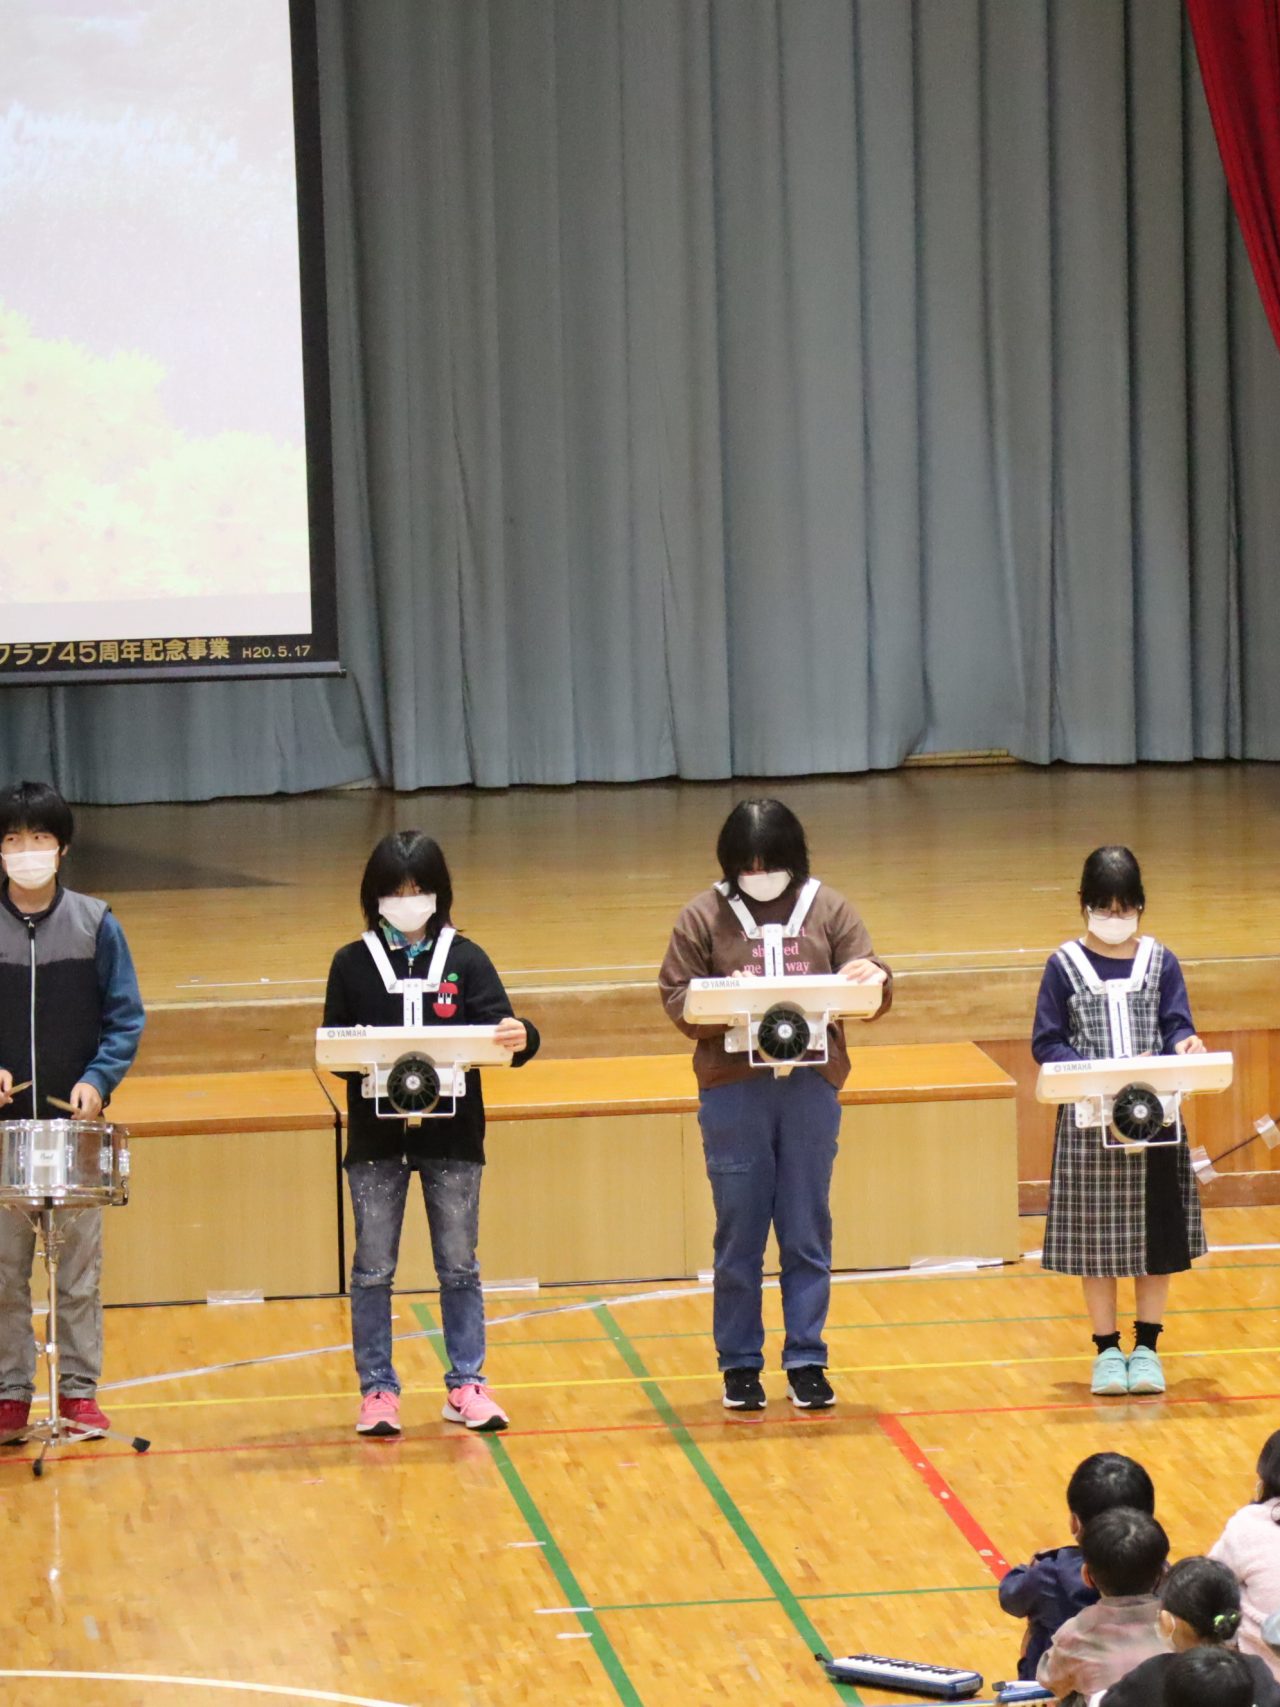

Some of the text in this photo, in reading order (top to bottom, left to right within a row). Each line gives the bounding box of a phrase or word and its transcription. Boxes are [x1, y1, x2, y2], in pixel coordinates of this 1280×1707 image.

[242, 645, 311, 659] H20.5.17
[785, 961, 810, 975] way
[711, 980, 740, 988] YAMAHA
[336, 1029, 367, 1038] YAMAHA
[1062, 1063, 1092, 1072] YAMAHA
